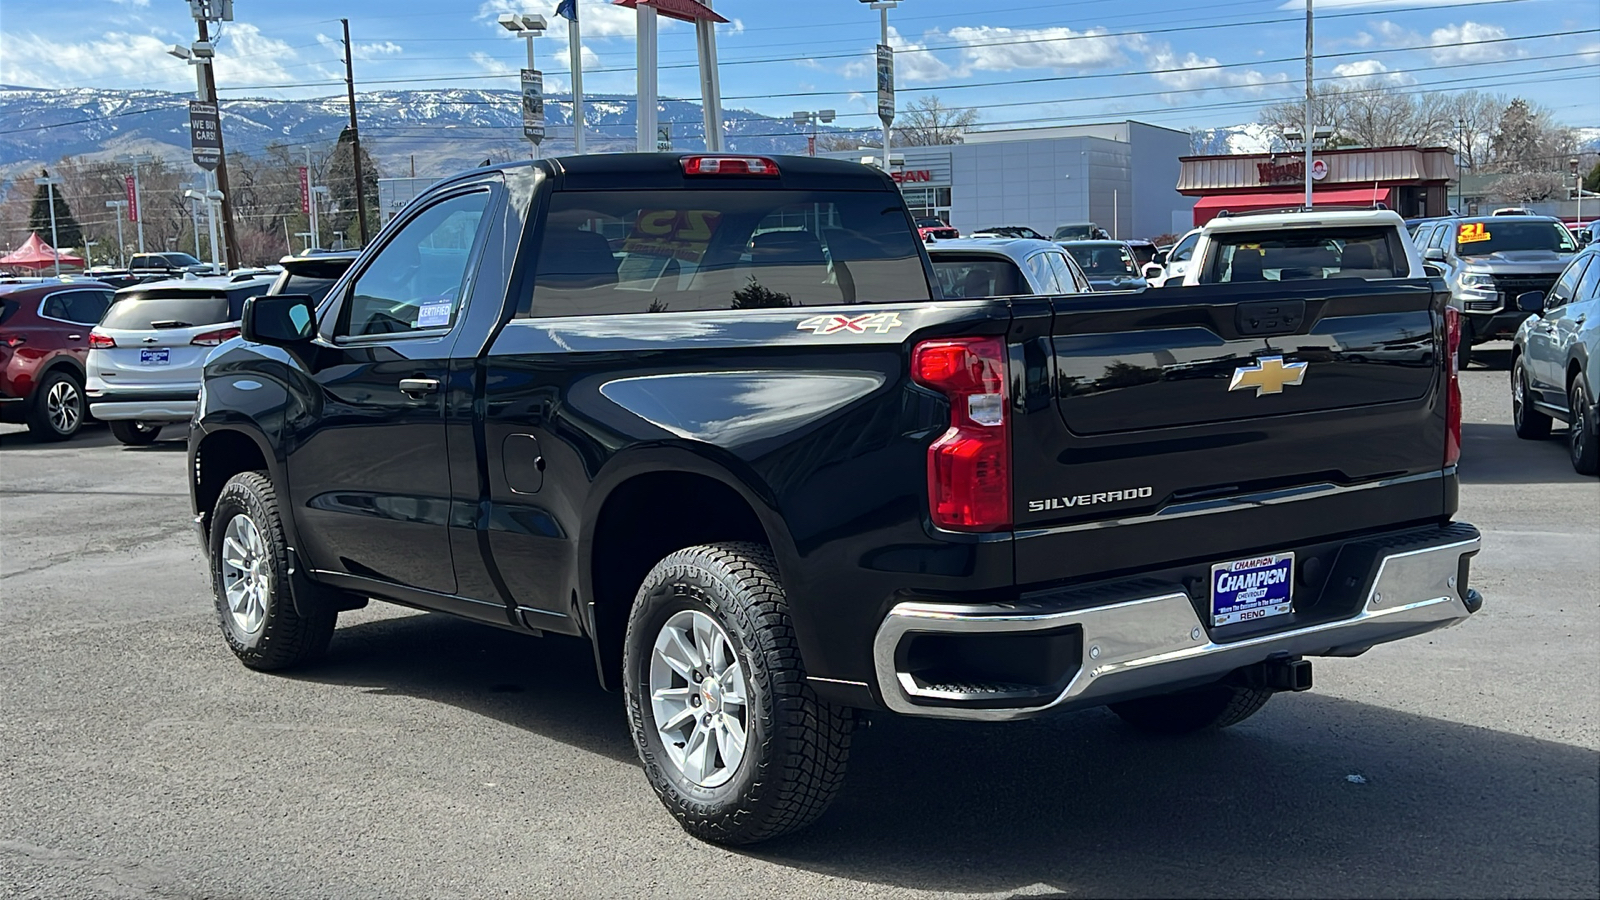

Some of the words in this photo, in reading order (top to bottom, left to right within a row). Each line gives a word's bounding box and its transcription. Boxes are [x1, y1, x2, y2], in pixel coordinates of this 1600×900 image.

[192, 120, 204, 129] WE
[196, 131, 216, 140] CARS!
[1461, 223, 1484, 235] 21
[420, 305, 450, 317] CERTIFIED
[1029, 486, 1152, 512] SILVERADO
[1235, 557, 1273, 569] CHAMPION
[1217, 567, 1288, 593] CHAMPION
[1237, 589, 1265, 599] CHEVROLET
[1240, 609, 1266, 620] RENO
